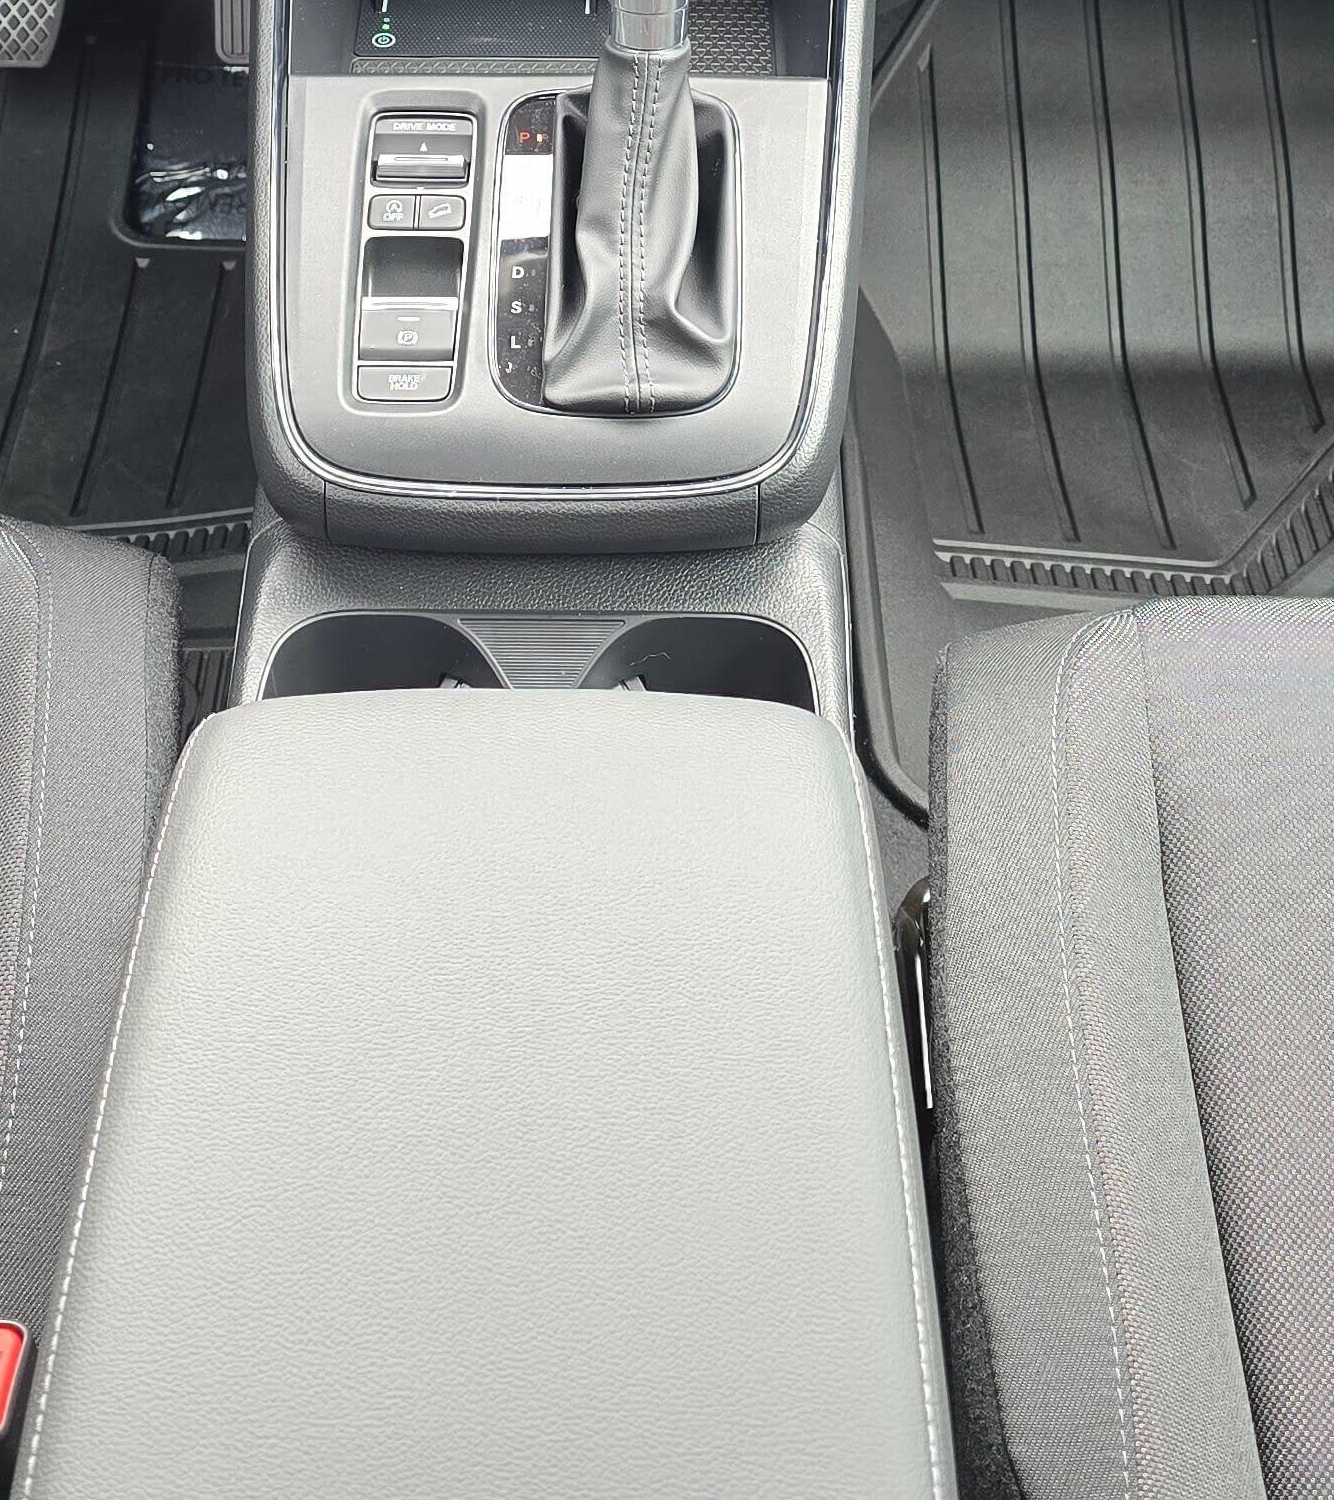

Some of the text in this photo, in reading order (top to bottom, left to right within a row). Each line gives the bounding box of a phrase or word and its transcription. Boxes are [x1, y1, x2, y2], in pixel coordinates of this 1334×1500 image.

[392, 122, 457, 132] DRIVE MODE
[519, 132, 530, 143] P
[511, 266, 524, 279] D
[510, 301, 523, 314] S
[510, 336, 522, 349] L
[388, 374, 421, 383] BRAKE
[389, 382, 419, 391] HOLD
